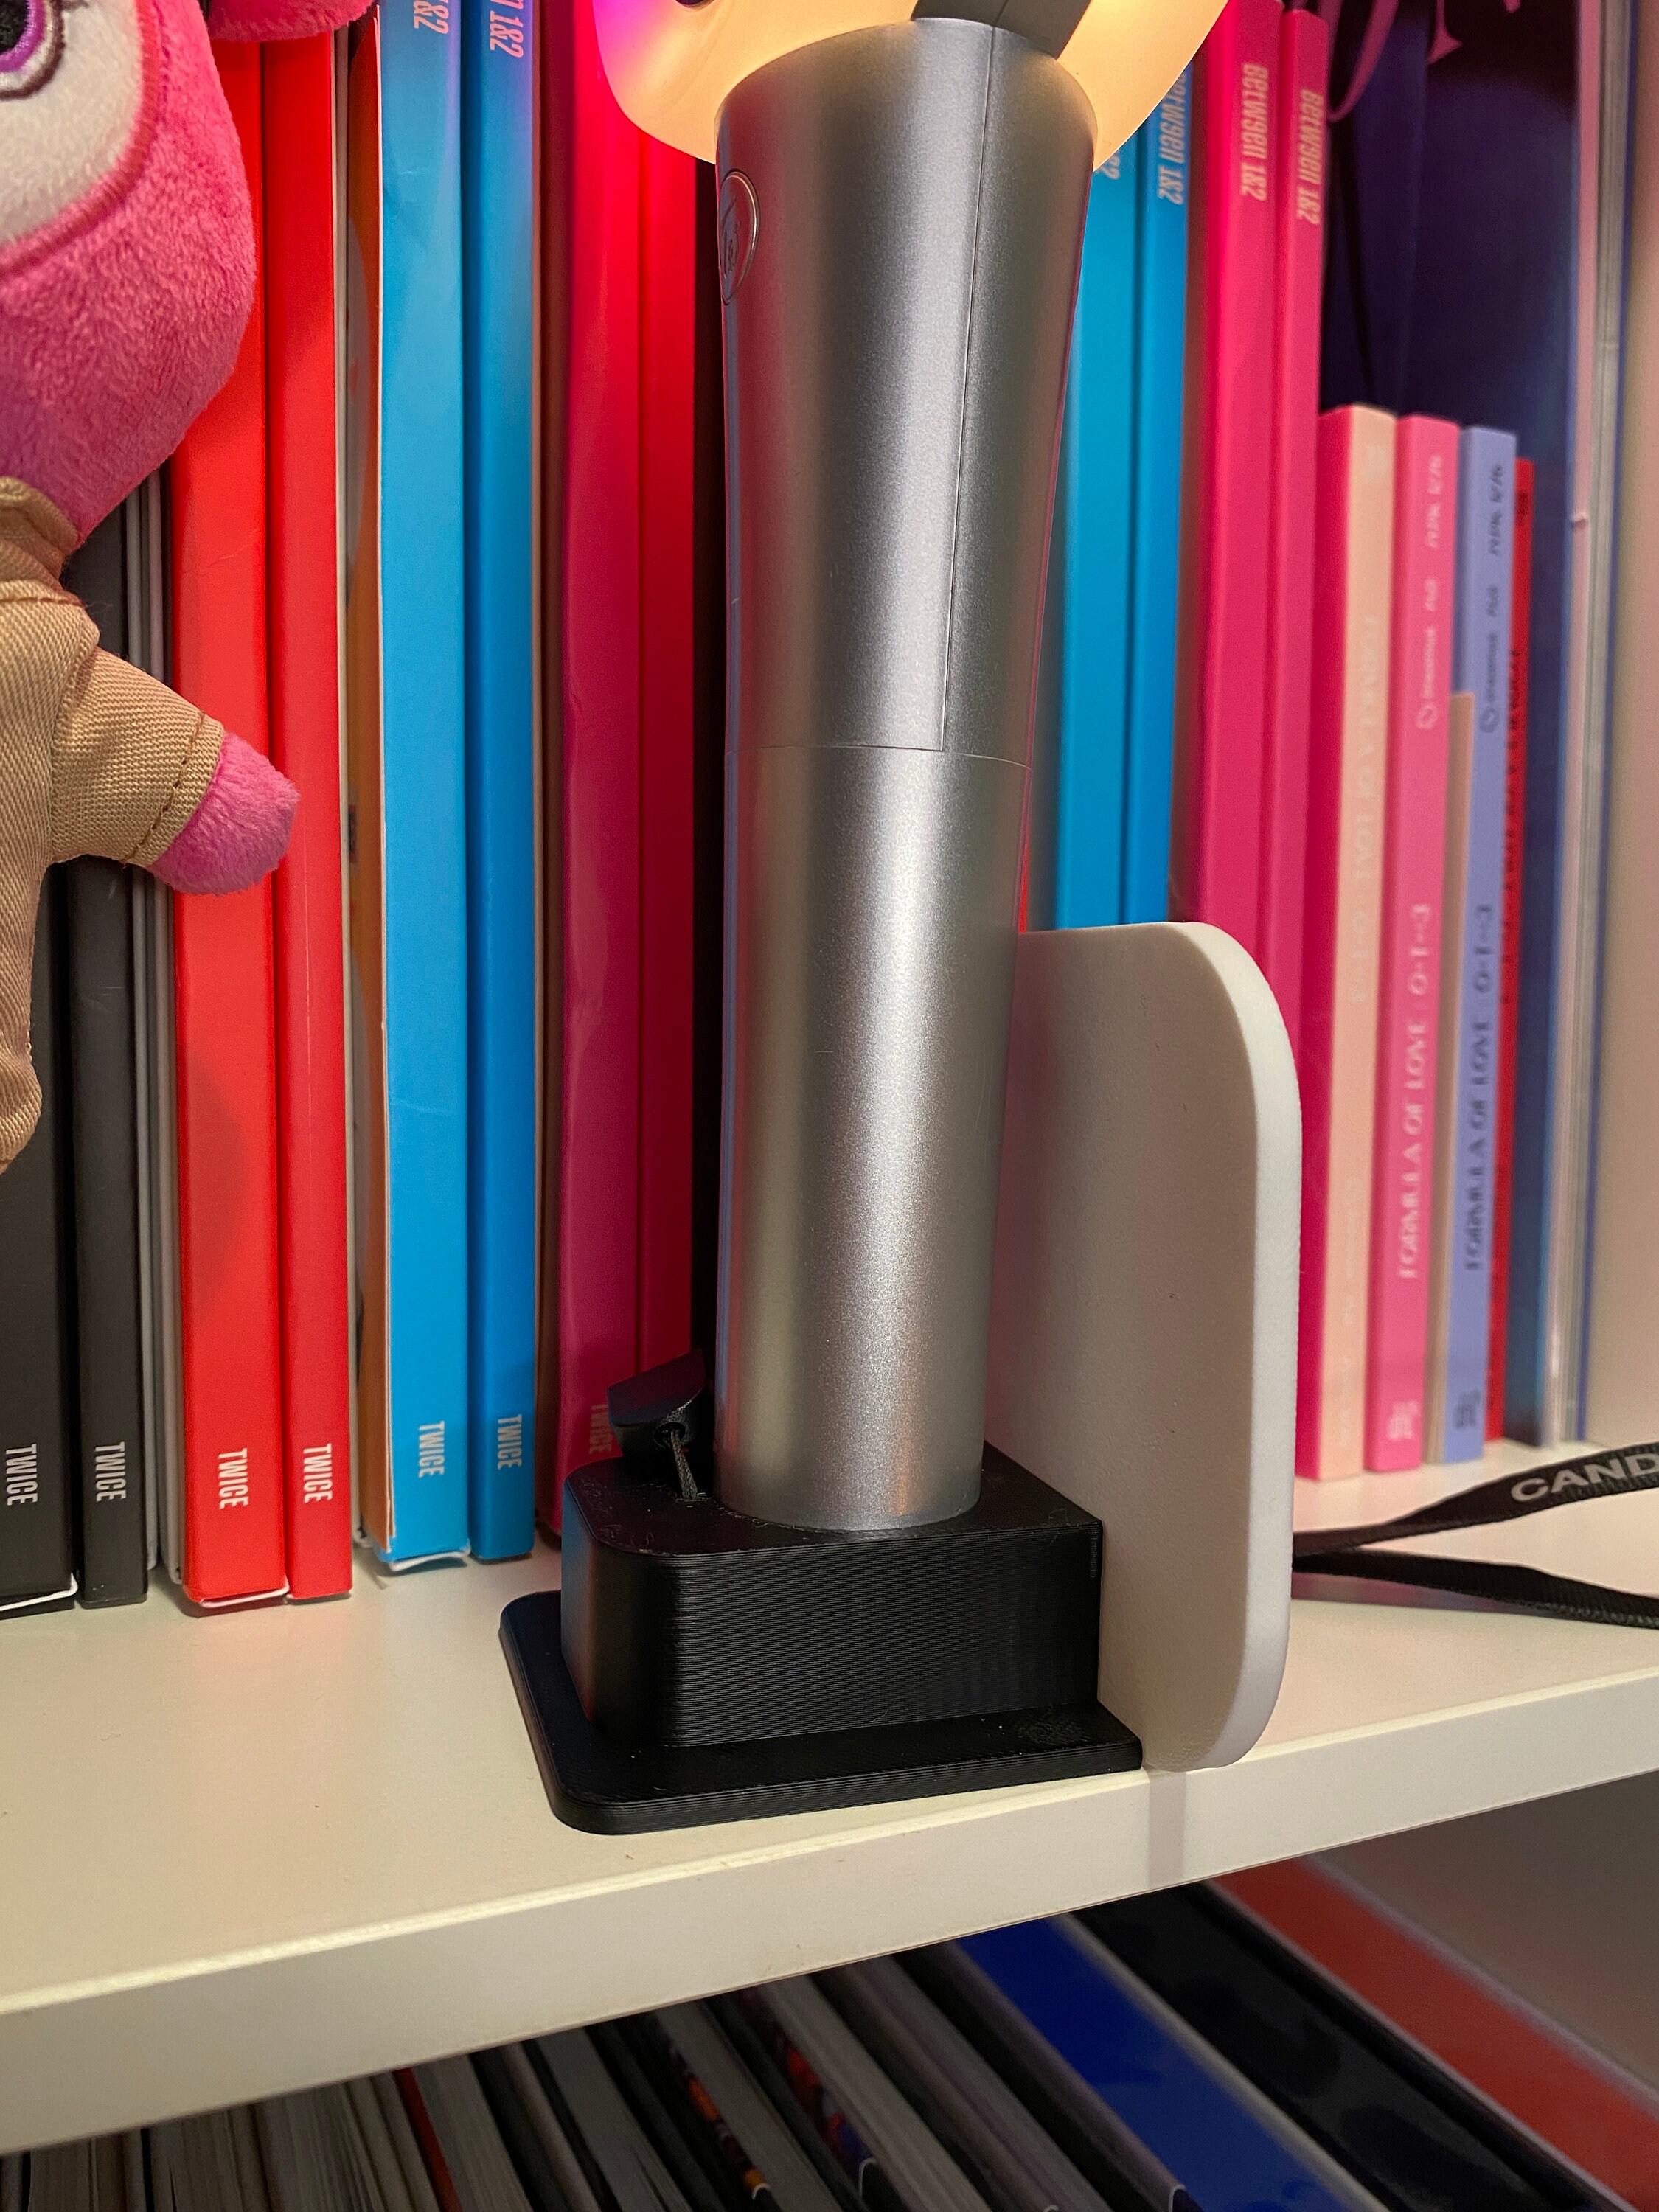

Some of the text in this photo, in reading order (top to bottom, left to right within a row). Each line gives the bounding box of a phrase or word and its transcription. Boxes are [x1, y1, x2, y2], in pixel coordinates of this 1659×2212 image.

[414, 0, 449, 35] &2
[490, 10, 524, 58] 1&2
[1157, 165, 1184, 205] 1&2
[1239, 162, 1267, 201] 1&2
[1297, 187, 1321, 225] 1&2
[418, 1420, 445, 1478] TWICE
[497, 1413, 522, 1470] TWICE
[6, 1444, 38, 1506] TWICE
[95, 1441, 127, 1501] TWICE
[218, 1447, 248, 1509] TWICE
[303, 1443, 333, 1503] TWICE
